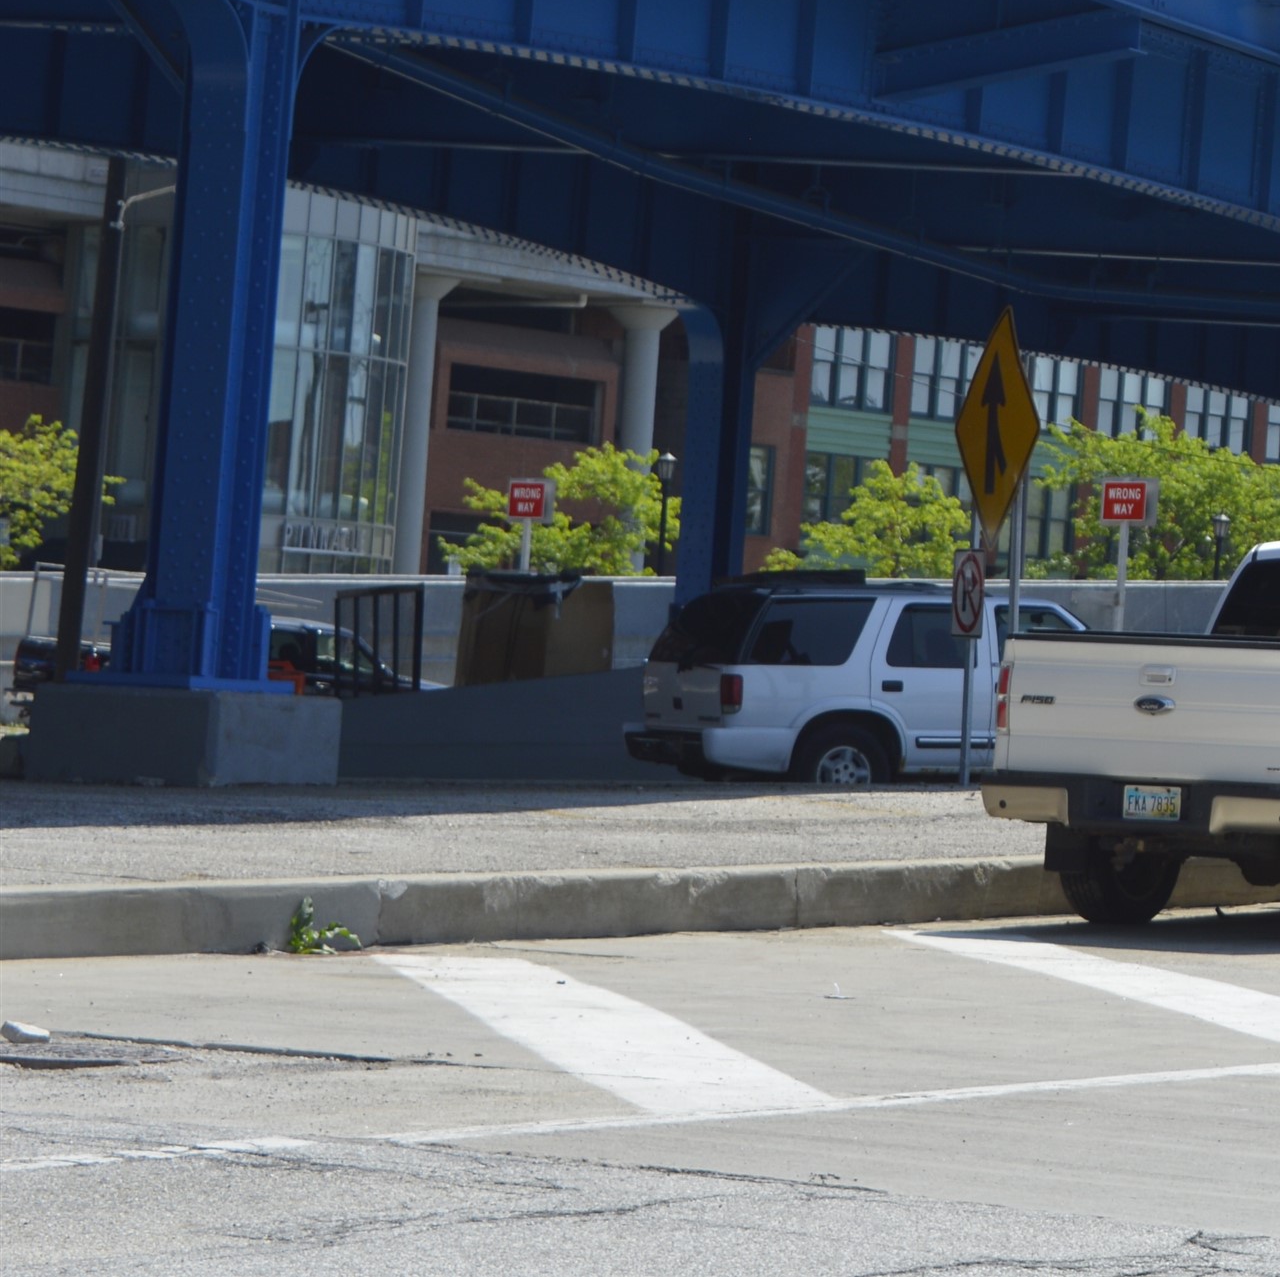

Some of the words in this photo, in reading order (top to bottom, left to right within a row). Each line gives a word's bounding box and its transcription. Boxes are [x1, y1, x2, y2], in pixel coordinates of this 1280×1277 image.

[513, 487, 541, 499] WRONG
[1109, 487, 1142, 500] WRONG
[517, 501, 535, 513] WAY
[1113, 502, 1135, 515] WAY
[1127, 794, 1147, 813] FKA
[1151, 795, 1176, 813] 7835
